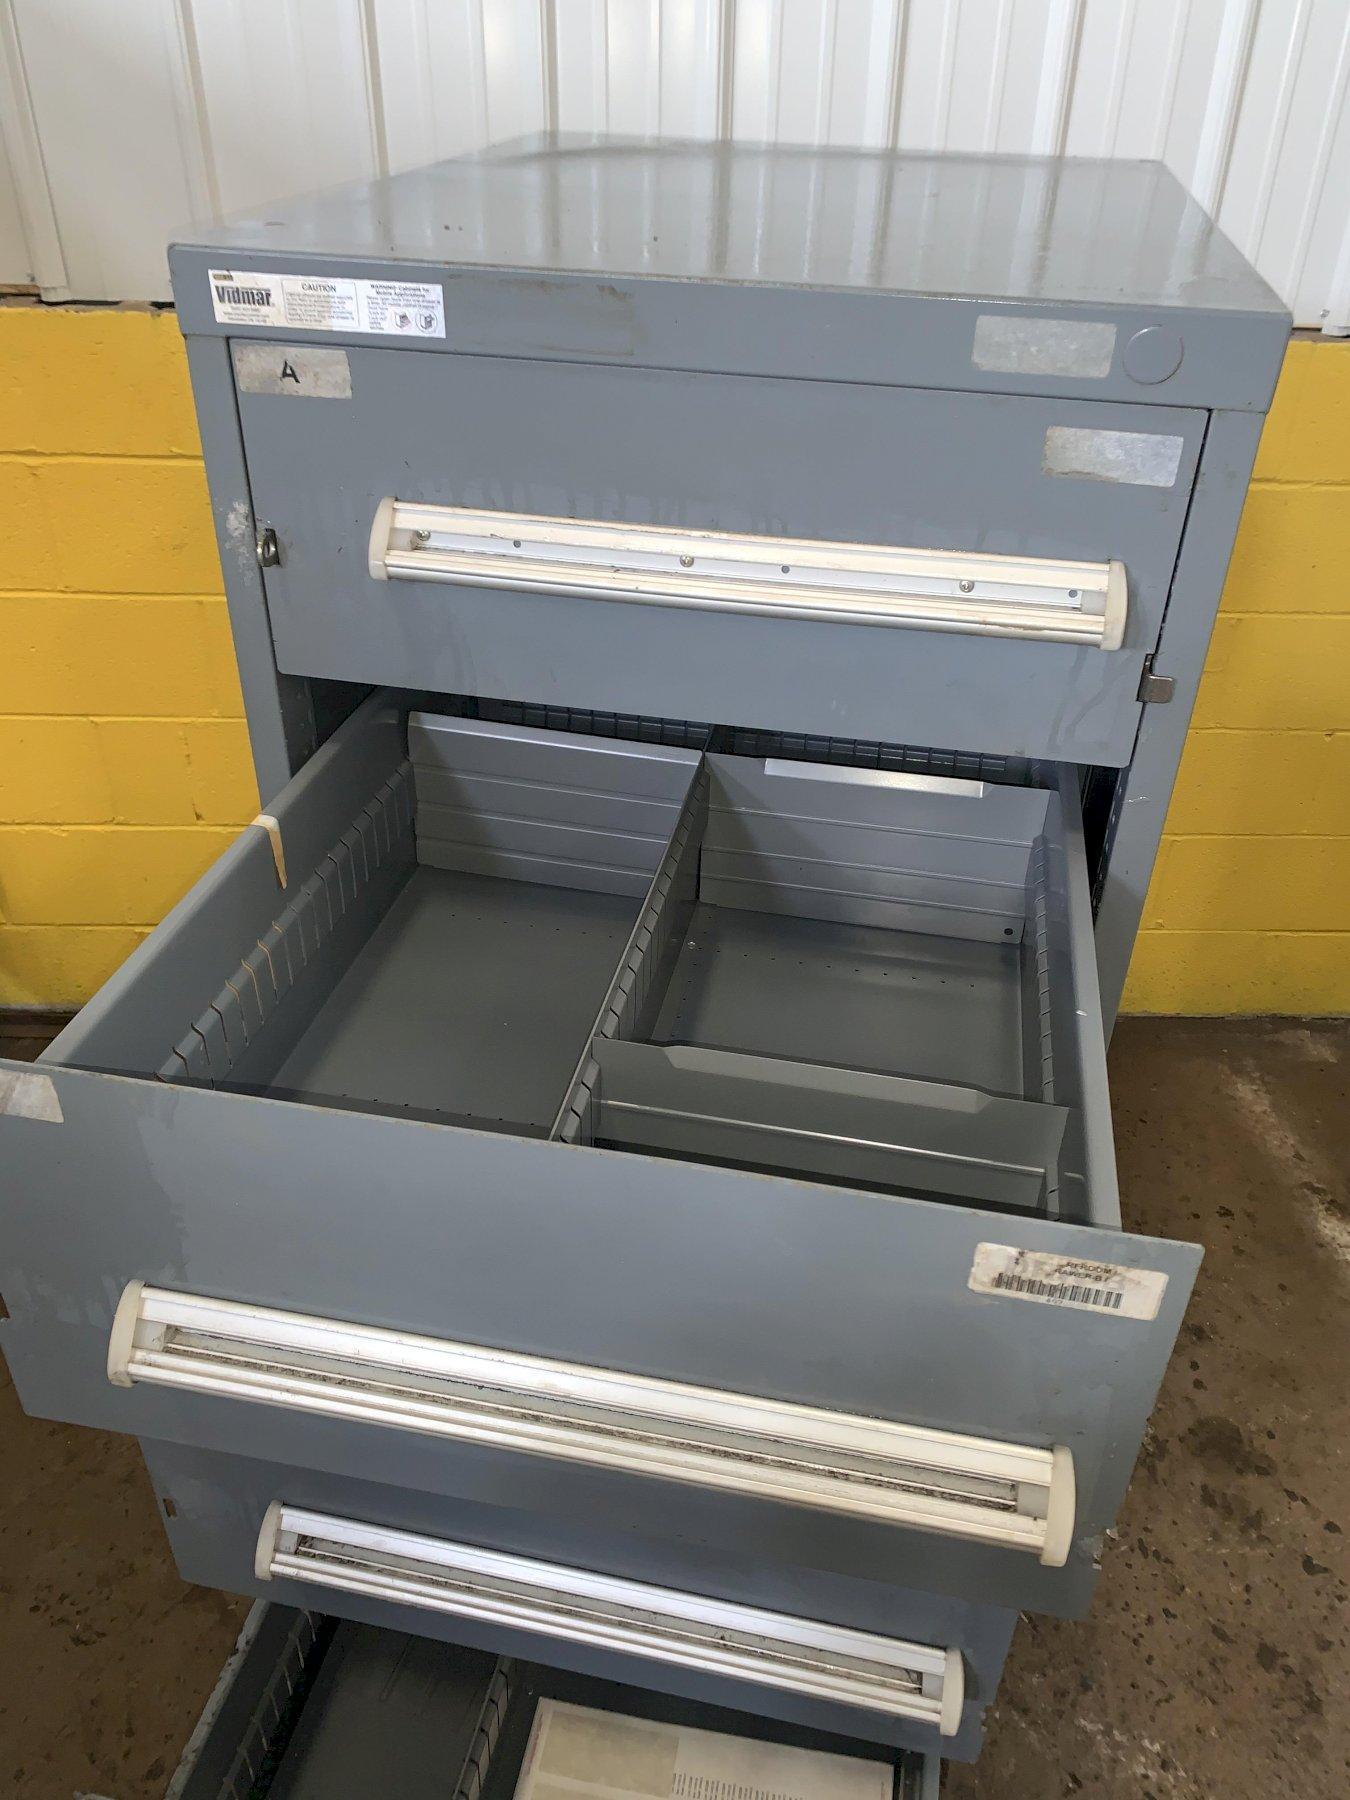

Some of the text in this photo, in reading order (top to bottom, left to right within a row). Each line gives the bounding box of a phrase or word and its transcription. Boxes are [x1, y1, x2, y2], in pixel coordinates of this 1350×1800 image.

[215, 285, 271, 307] Vidmar
[301, 282, 337, 293] CAUTION
[281, 360, 301, 384] A
